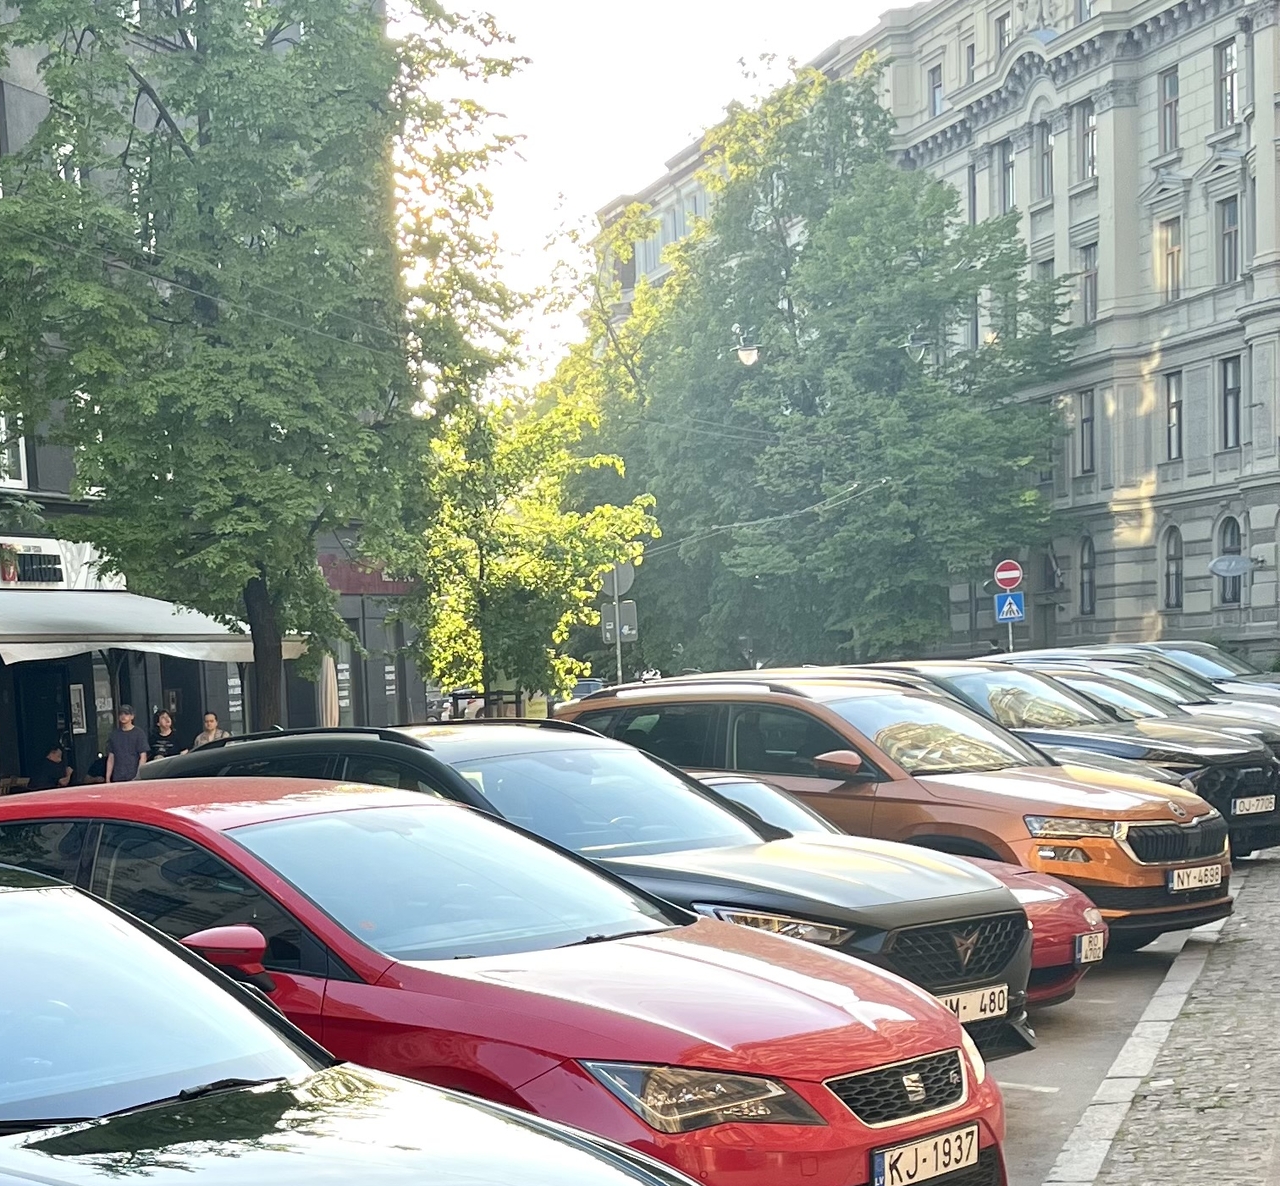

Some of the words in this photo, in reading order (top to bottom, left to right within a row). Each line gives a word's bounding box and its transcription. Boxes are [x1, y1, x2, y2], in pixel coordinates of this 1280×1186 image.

[1176, 866, 1220, 888] NY-4698
[979, 989, 1005, 1015] 480
[888, 1129, 975, 1186] KJ-1937
[874, 1175, 885, 1186] LV
